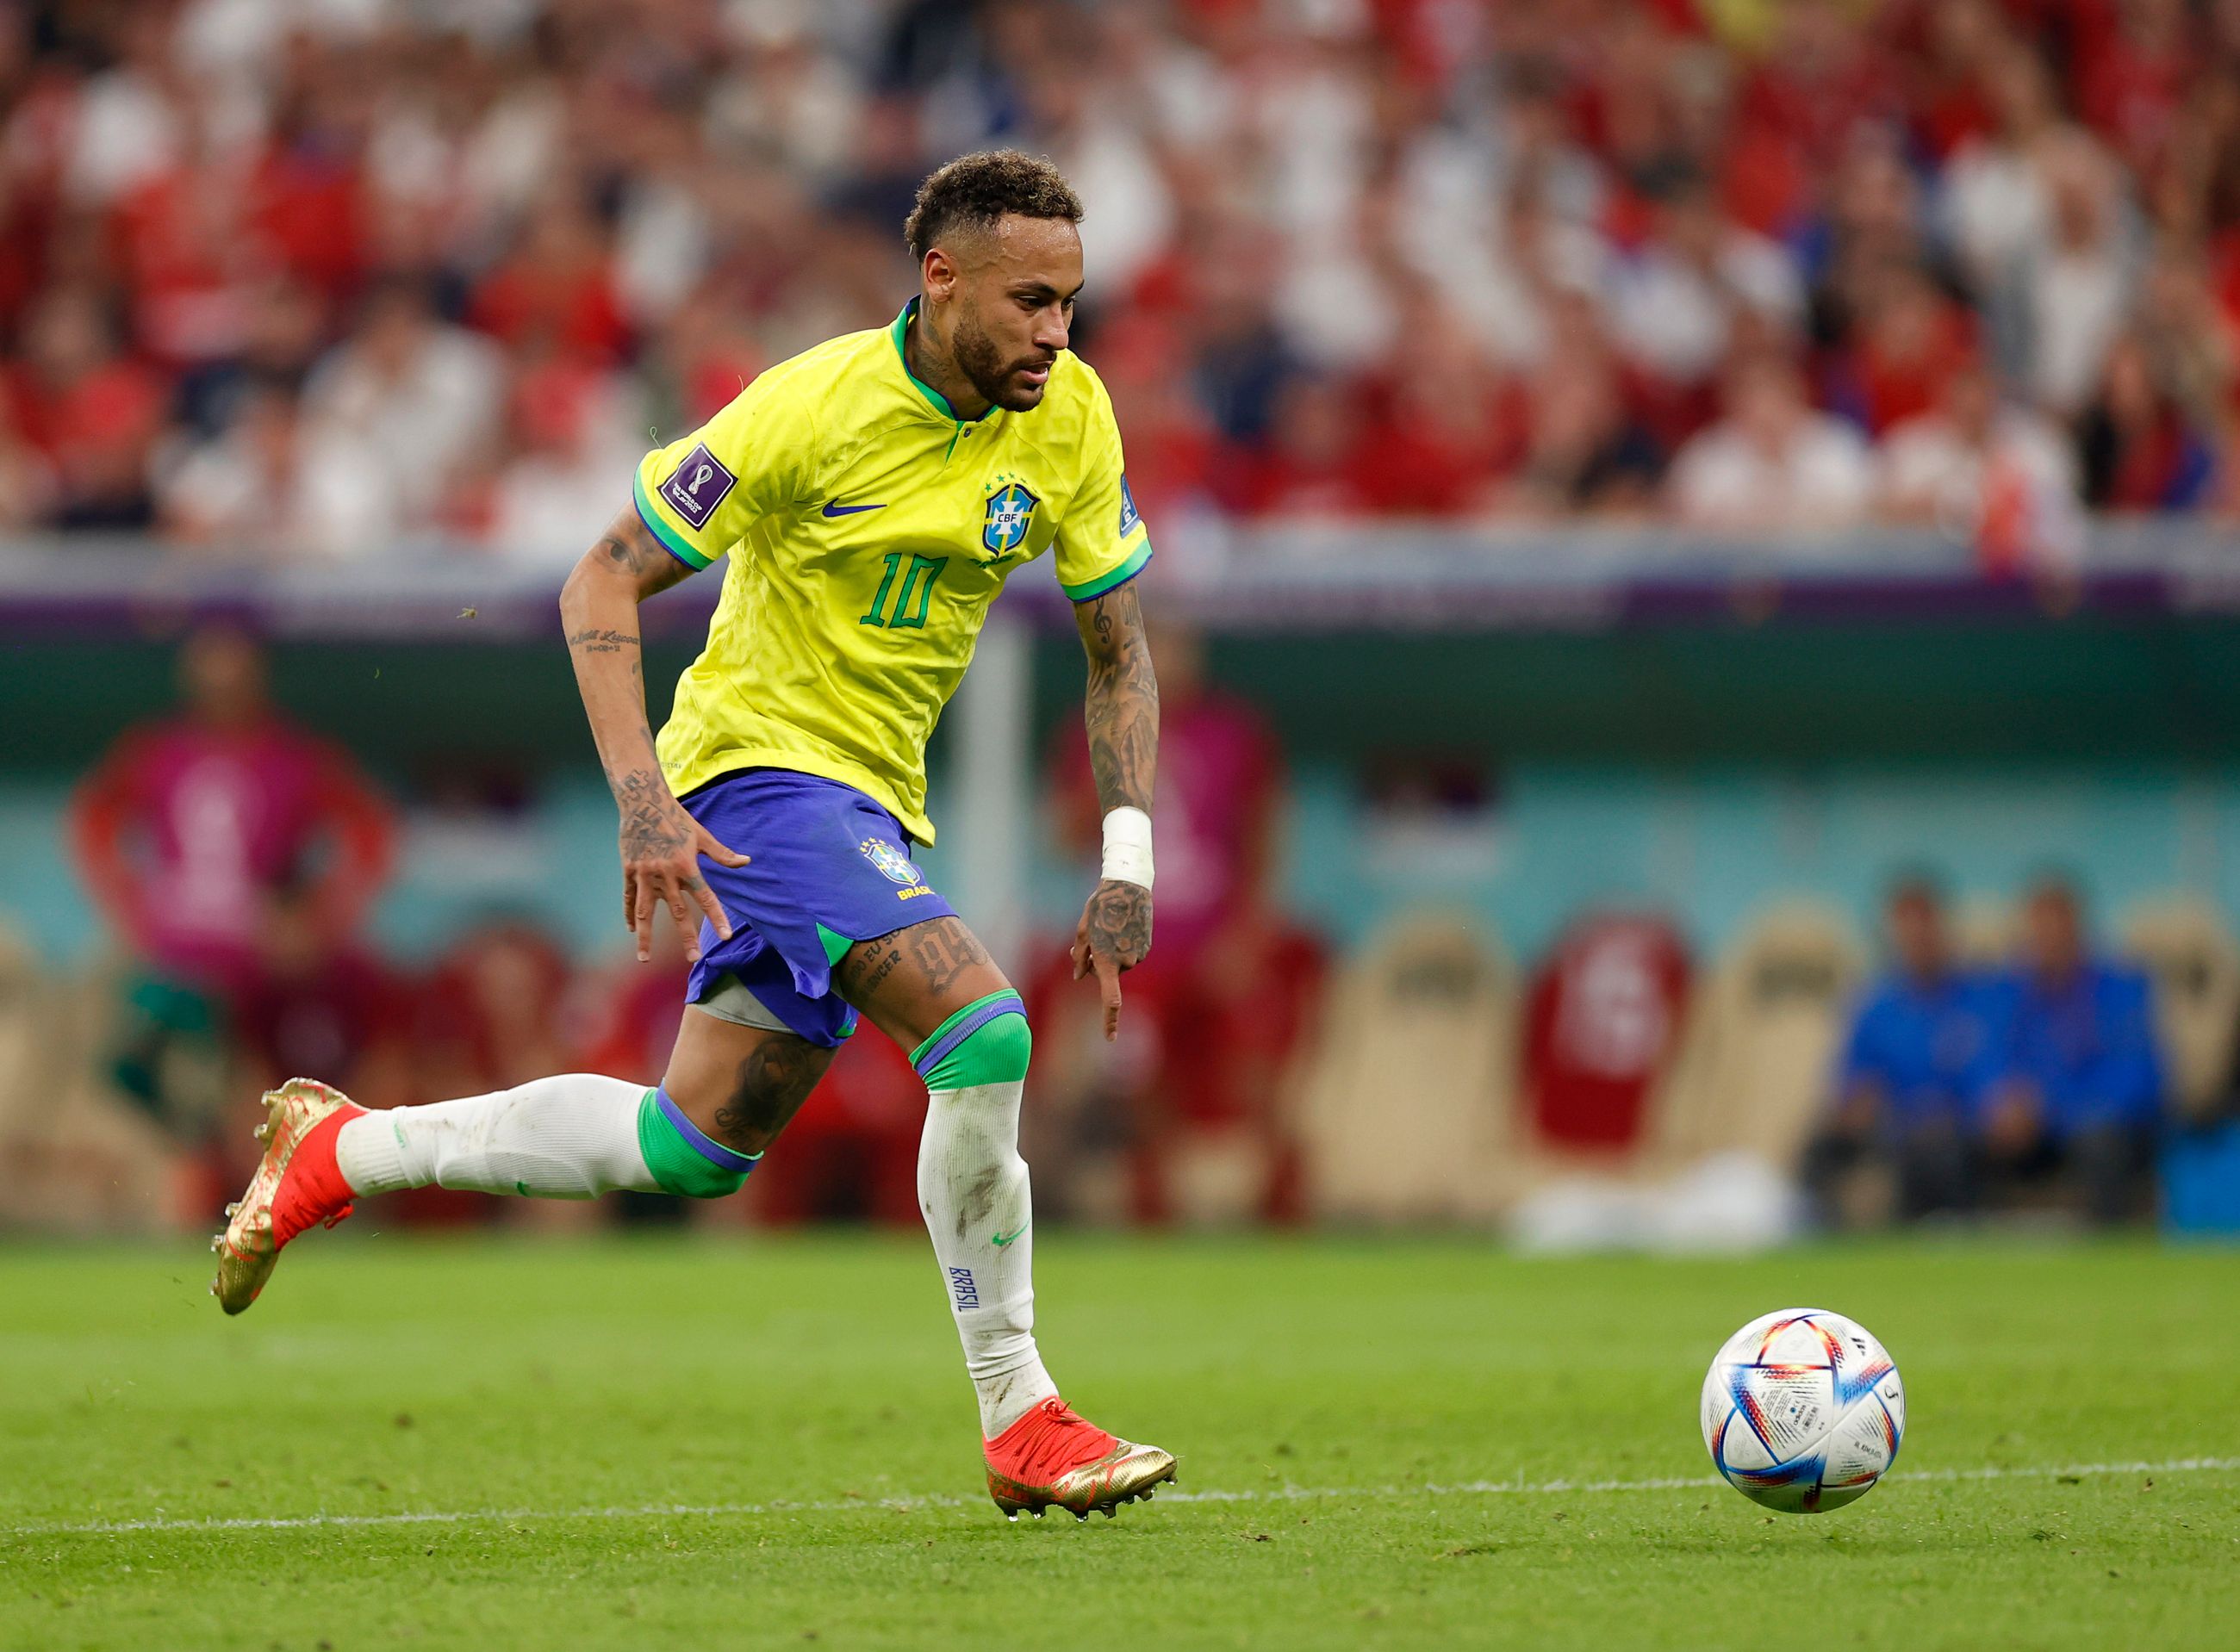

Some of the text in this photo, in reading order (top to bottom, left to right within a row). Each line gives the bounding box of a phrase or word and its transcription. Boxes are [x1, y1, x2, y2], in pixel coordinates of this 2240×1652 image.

[998, 512, 1017, 523] CBF
[859, 552, 949, 630] 10
[949, 1266, 980, 1313] BRASIL
[1794, 1405, 1807, 1425] adidas
